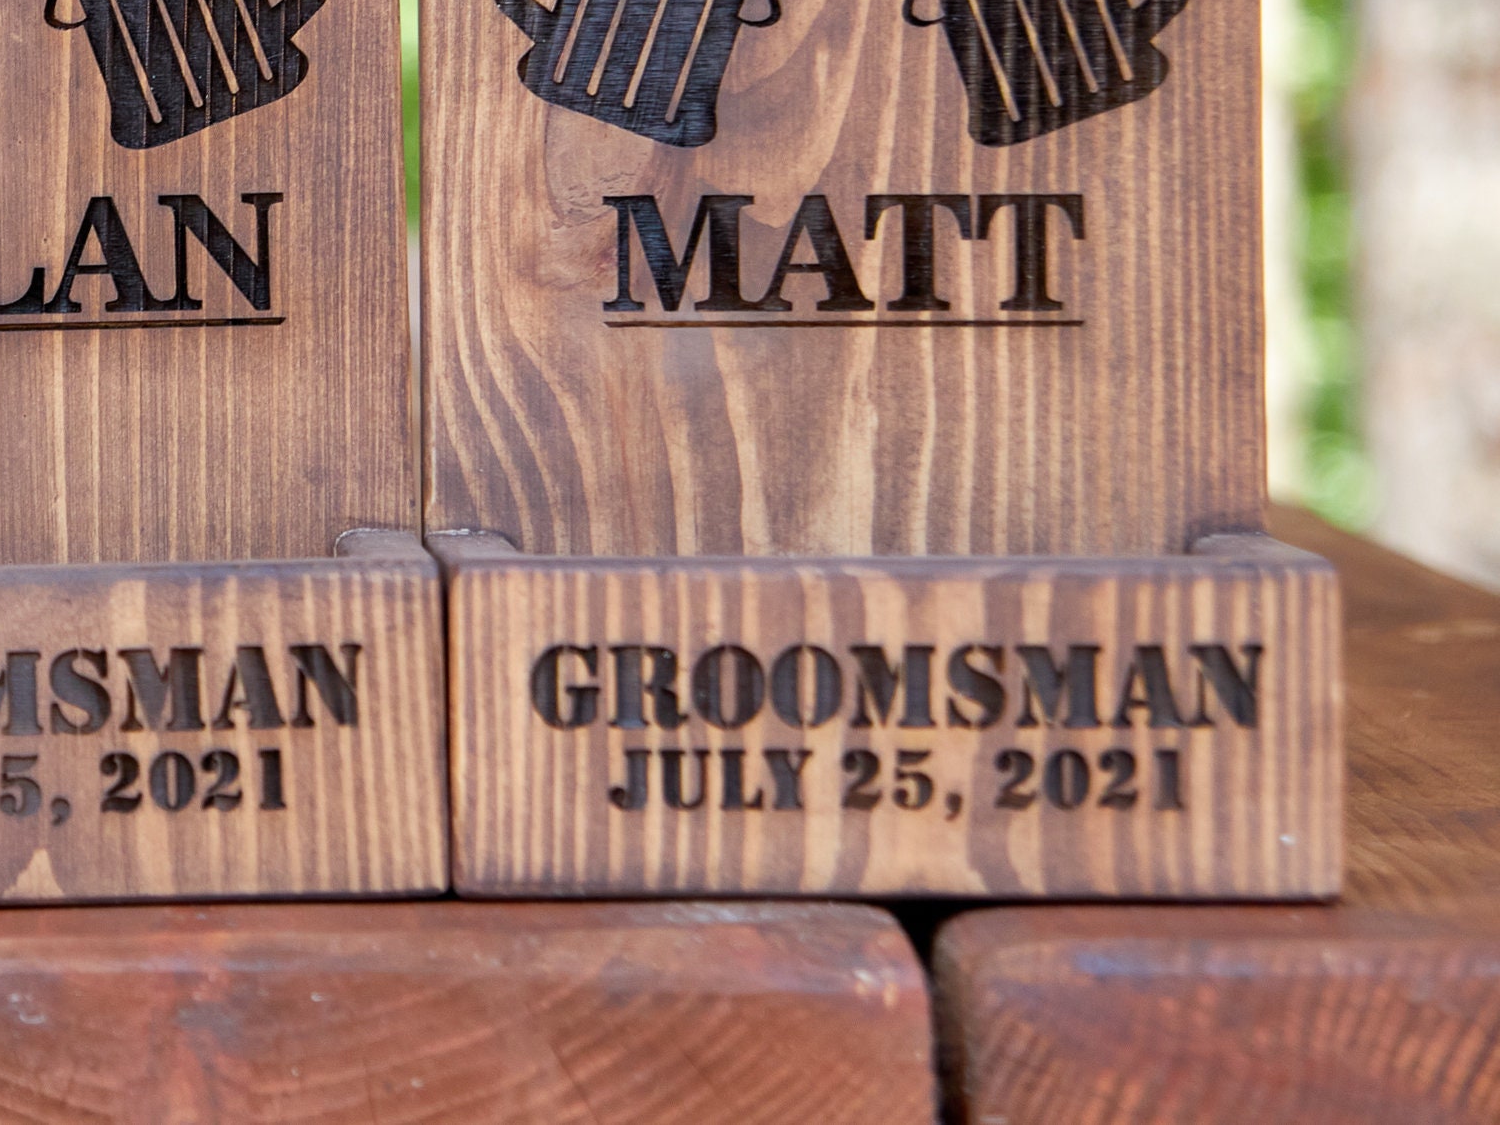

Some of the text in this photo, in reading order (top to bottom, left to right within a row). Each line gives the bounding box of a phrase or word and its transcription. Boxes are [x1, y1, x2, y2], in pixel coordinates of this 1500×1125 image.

[603, 194, 1085, 312] MATT
[530, 642, 1264, 730] GROOMSMAN
[100, 748, 287, 812] 2021
[609, 748, 1184, 821] JULY 25, 2021
